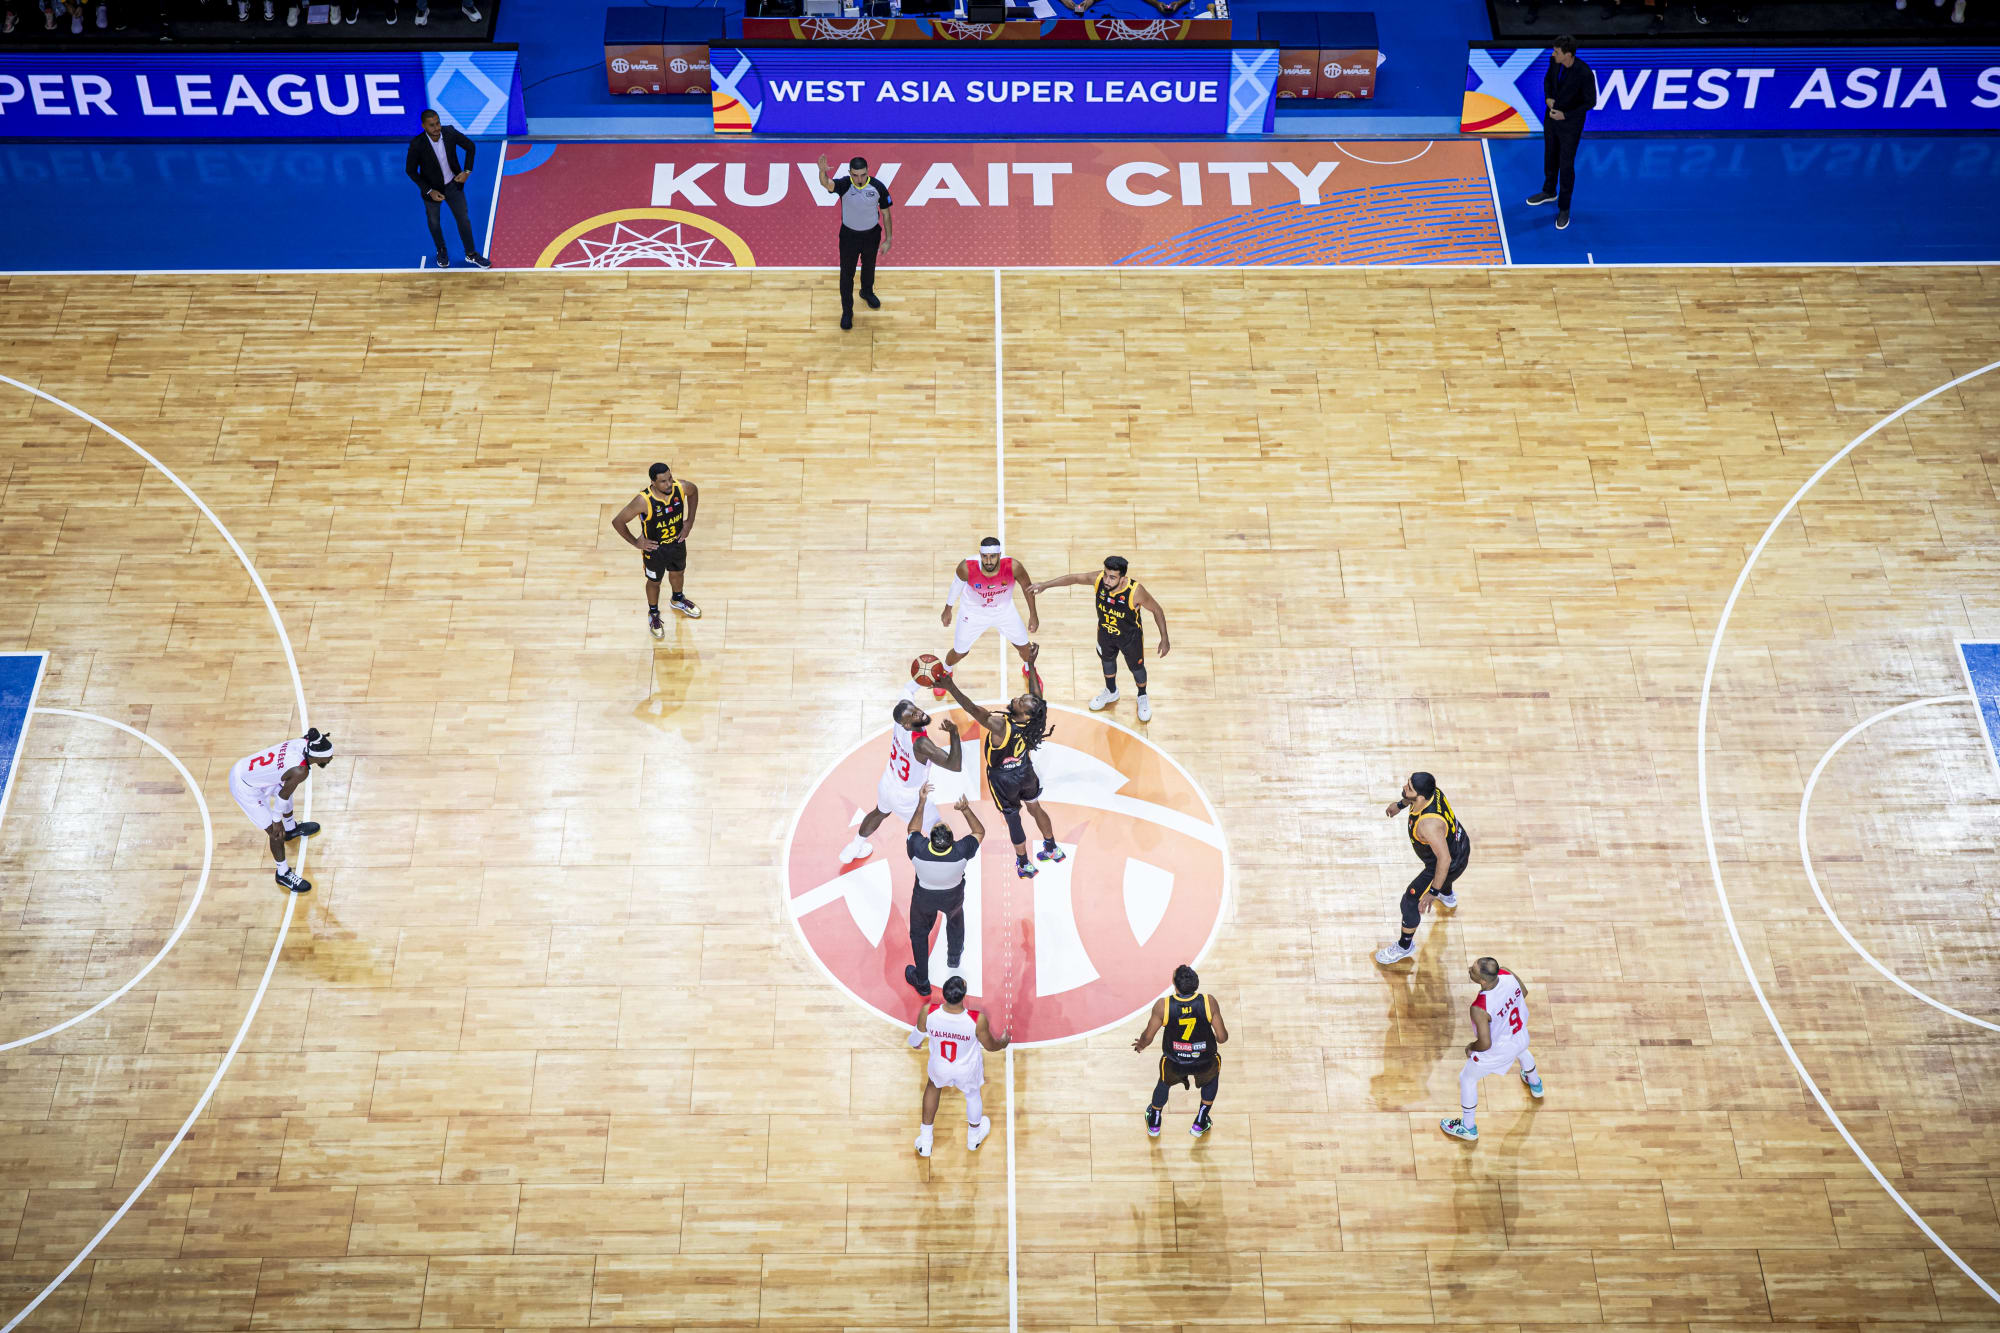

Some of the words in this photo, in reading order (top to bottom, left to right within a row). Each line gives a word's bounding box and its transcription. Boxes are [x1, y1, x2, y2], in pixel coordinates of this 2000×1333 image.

[136, 75, 405, 116] LEAGUE
[769, 81, 865, 103] WEST
[876, 81, 955, 103] ASIA
[968, 80, 1074, 103] SUPER
[1086, 80, 1218, 103] LEAGUE
[1592, 68, 1775, 111] WEST
[1790, 67, 1947, 109] ASIA
[1105, 161, 1340, 207] CITY
[661, 525, 676, 539] 23
[1103, 613, 1118, 626] 12
[248, 752, 275, 772] 2
[1181, 1006, 1193, 1014] MJ
[1509, 1006, 1524, 1035] 9
[1178, 1017, 1197, 1041] 7
[940, 1040, 957, 1063] 0
